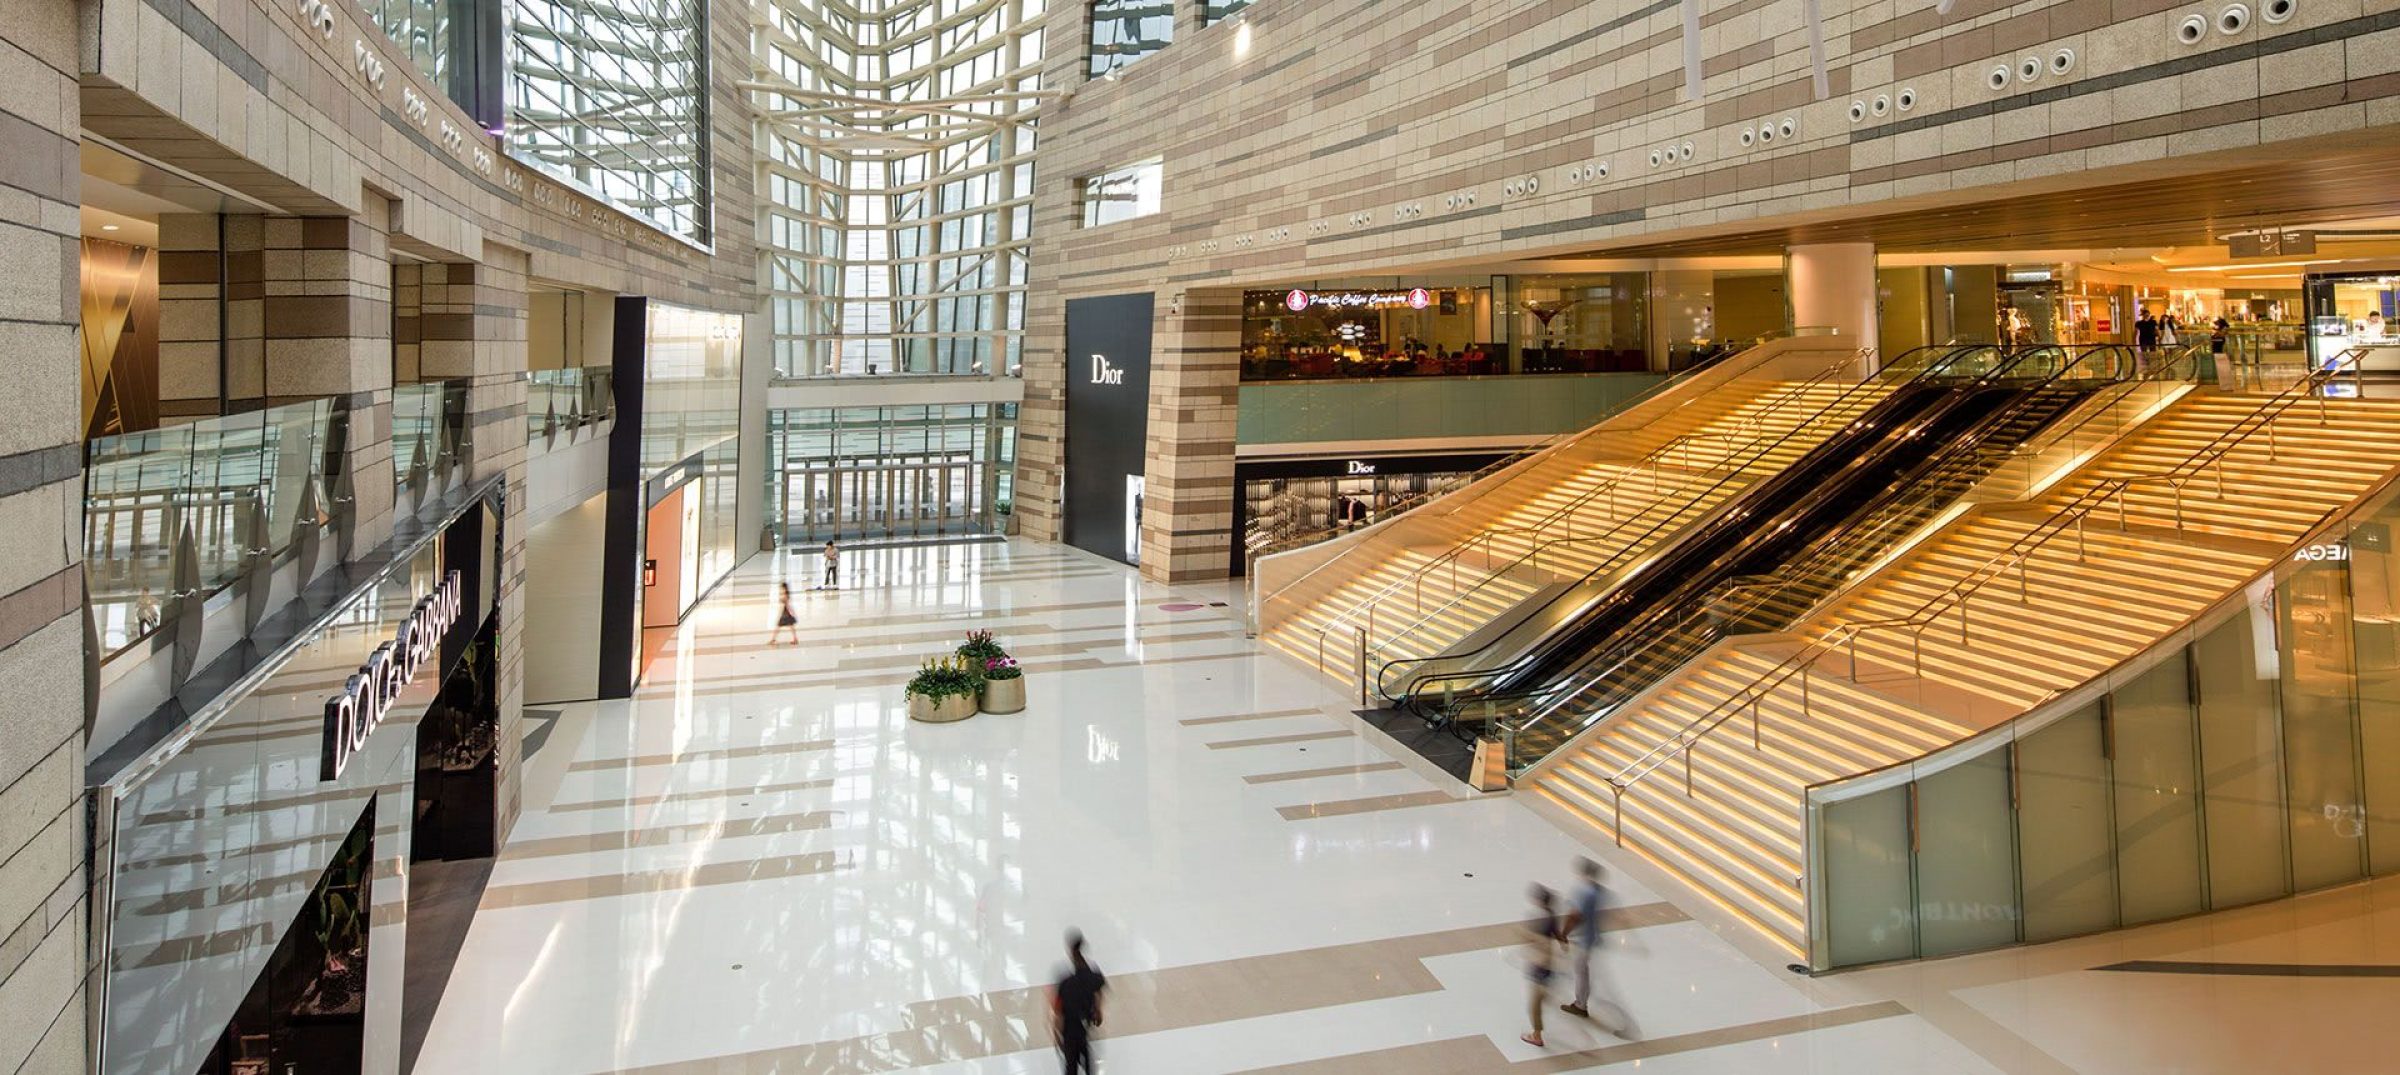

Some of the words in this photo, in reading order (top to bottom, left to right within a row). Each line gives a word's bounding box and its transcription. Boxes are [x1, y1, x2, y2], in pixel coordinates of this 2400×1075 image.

[1341, 294, 1367, 306] Coffee
[1090, 354, 1124, 385] Dior
[1347, 460, 1376, 474] Dior
[334, 640, 398, 780] DOLCE
[404, 569, 462, 685] GABBANA
